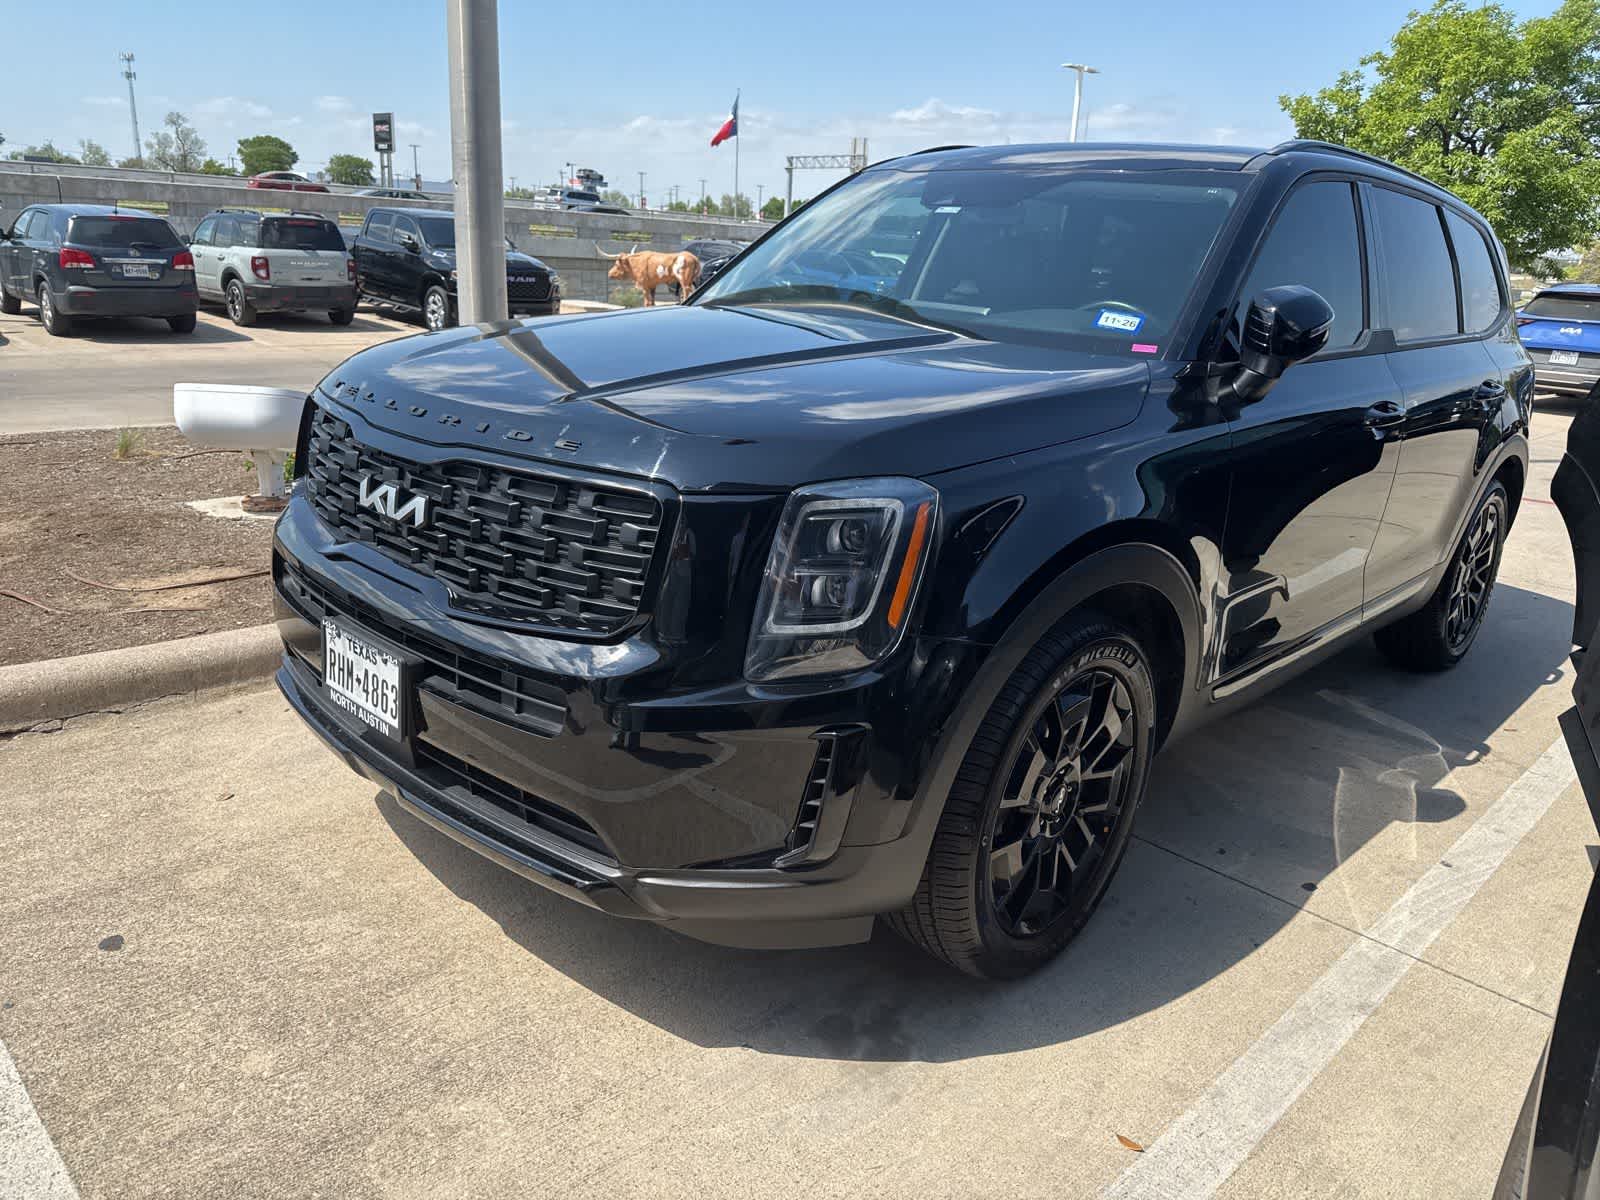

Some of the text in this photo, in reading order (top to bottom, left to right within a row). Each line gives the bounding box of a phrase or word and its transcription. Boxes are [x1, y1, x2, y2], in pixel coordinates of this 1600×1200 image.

[335, 379, 583, 452] TELLURIDE
[359, 474, 428, 528] KIA
[347, 637, 378, 665] TEXAS
[1078, 646, 1137, 667] MICHELIN
[330, 689, 389, 736] NORTH AUSTIN
